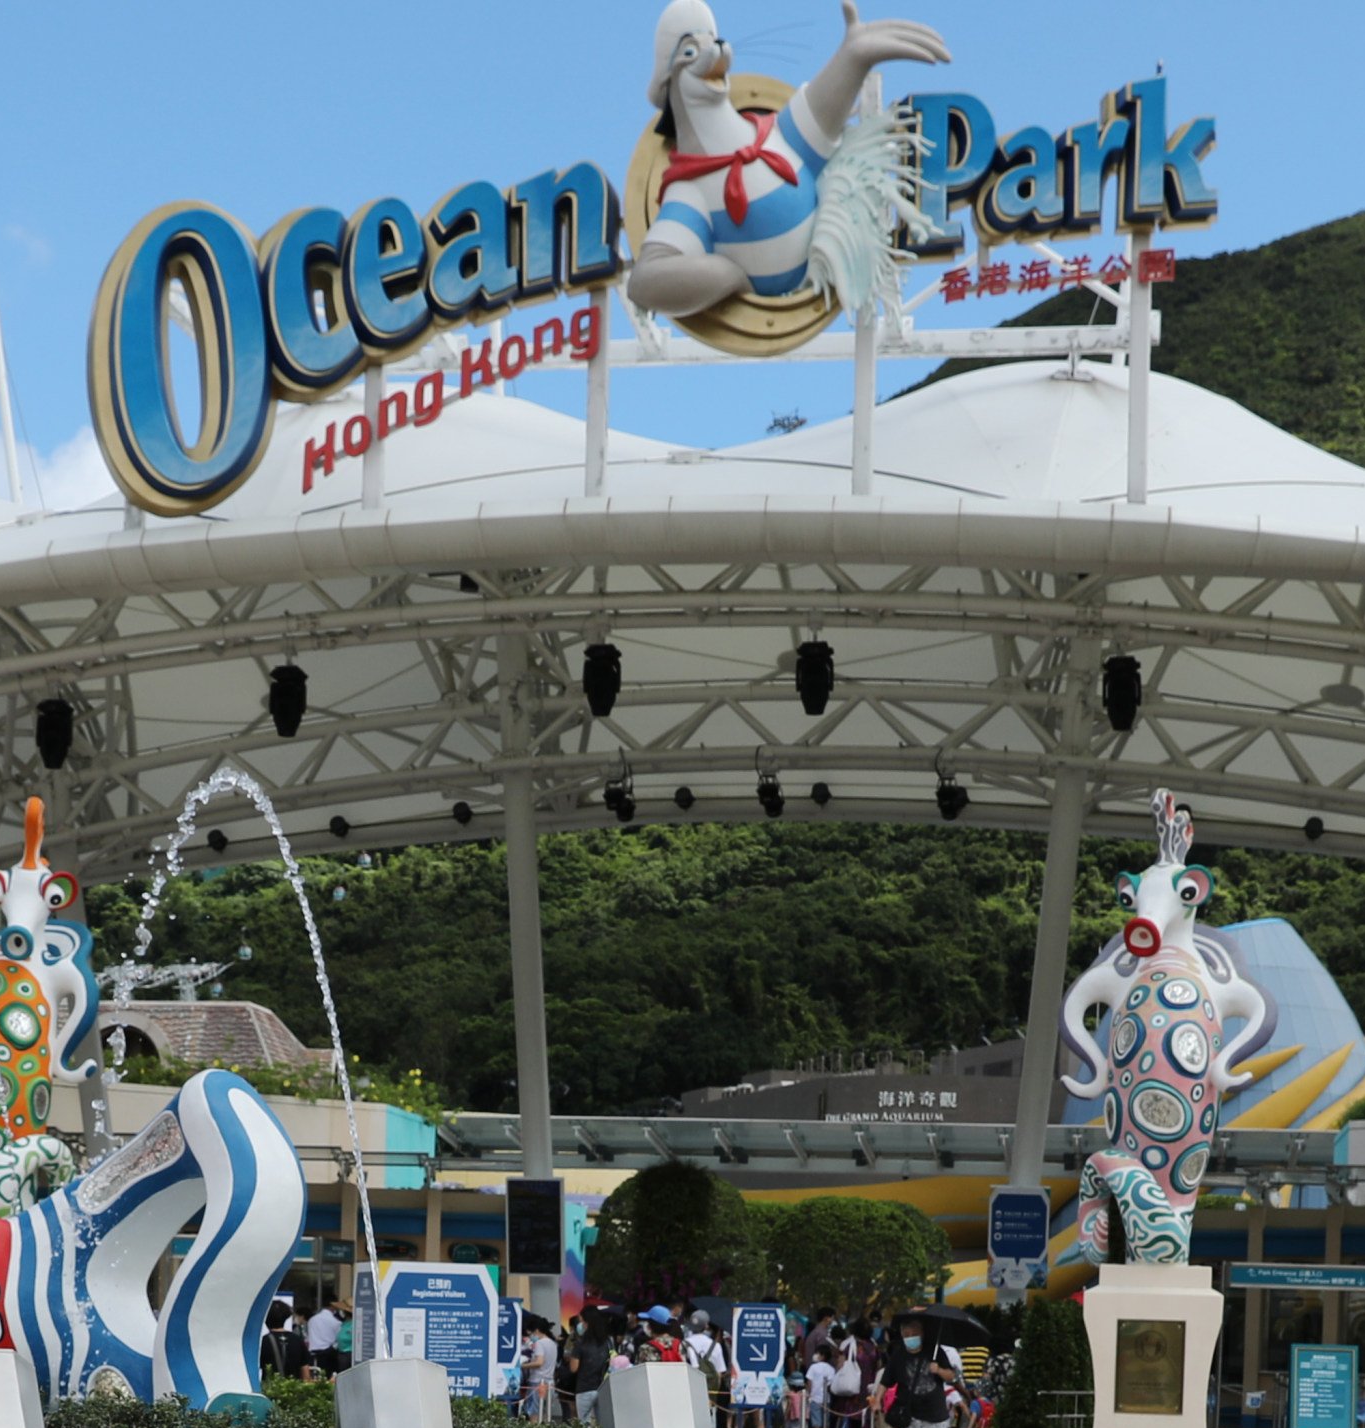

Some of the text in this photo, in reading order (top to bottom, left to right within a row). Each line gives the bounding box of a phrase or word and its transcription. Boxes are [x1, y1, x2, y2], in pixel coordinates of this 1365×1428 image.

[87, 76, 1218, 518] Ocean Park
[939, 248, 1175, 304] 香港海洋公園
[301, 305, 601, 495] Hong Kong
[878, 1091, 958, 1108] 海洋奇觀
[412, 1289, 466, 1299] Registered Visitors
